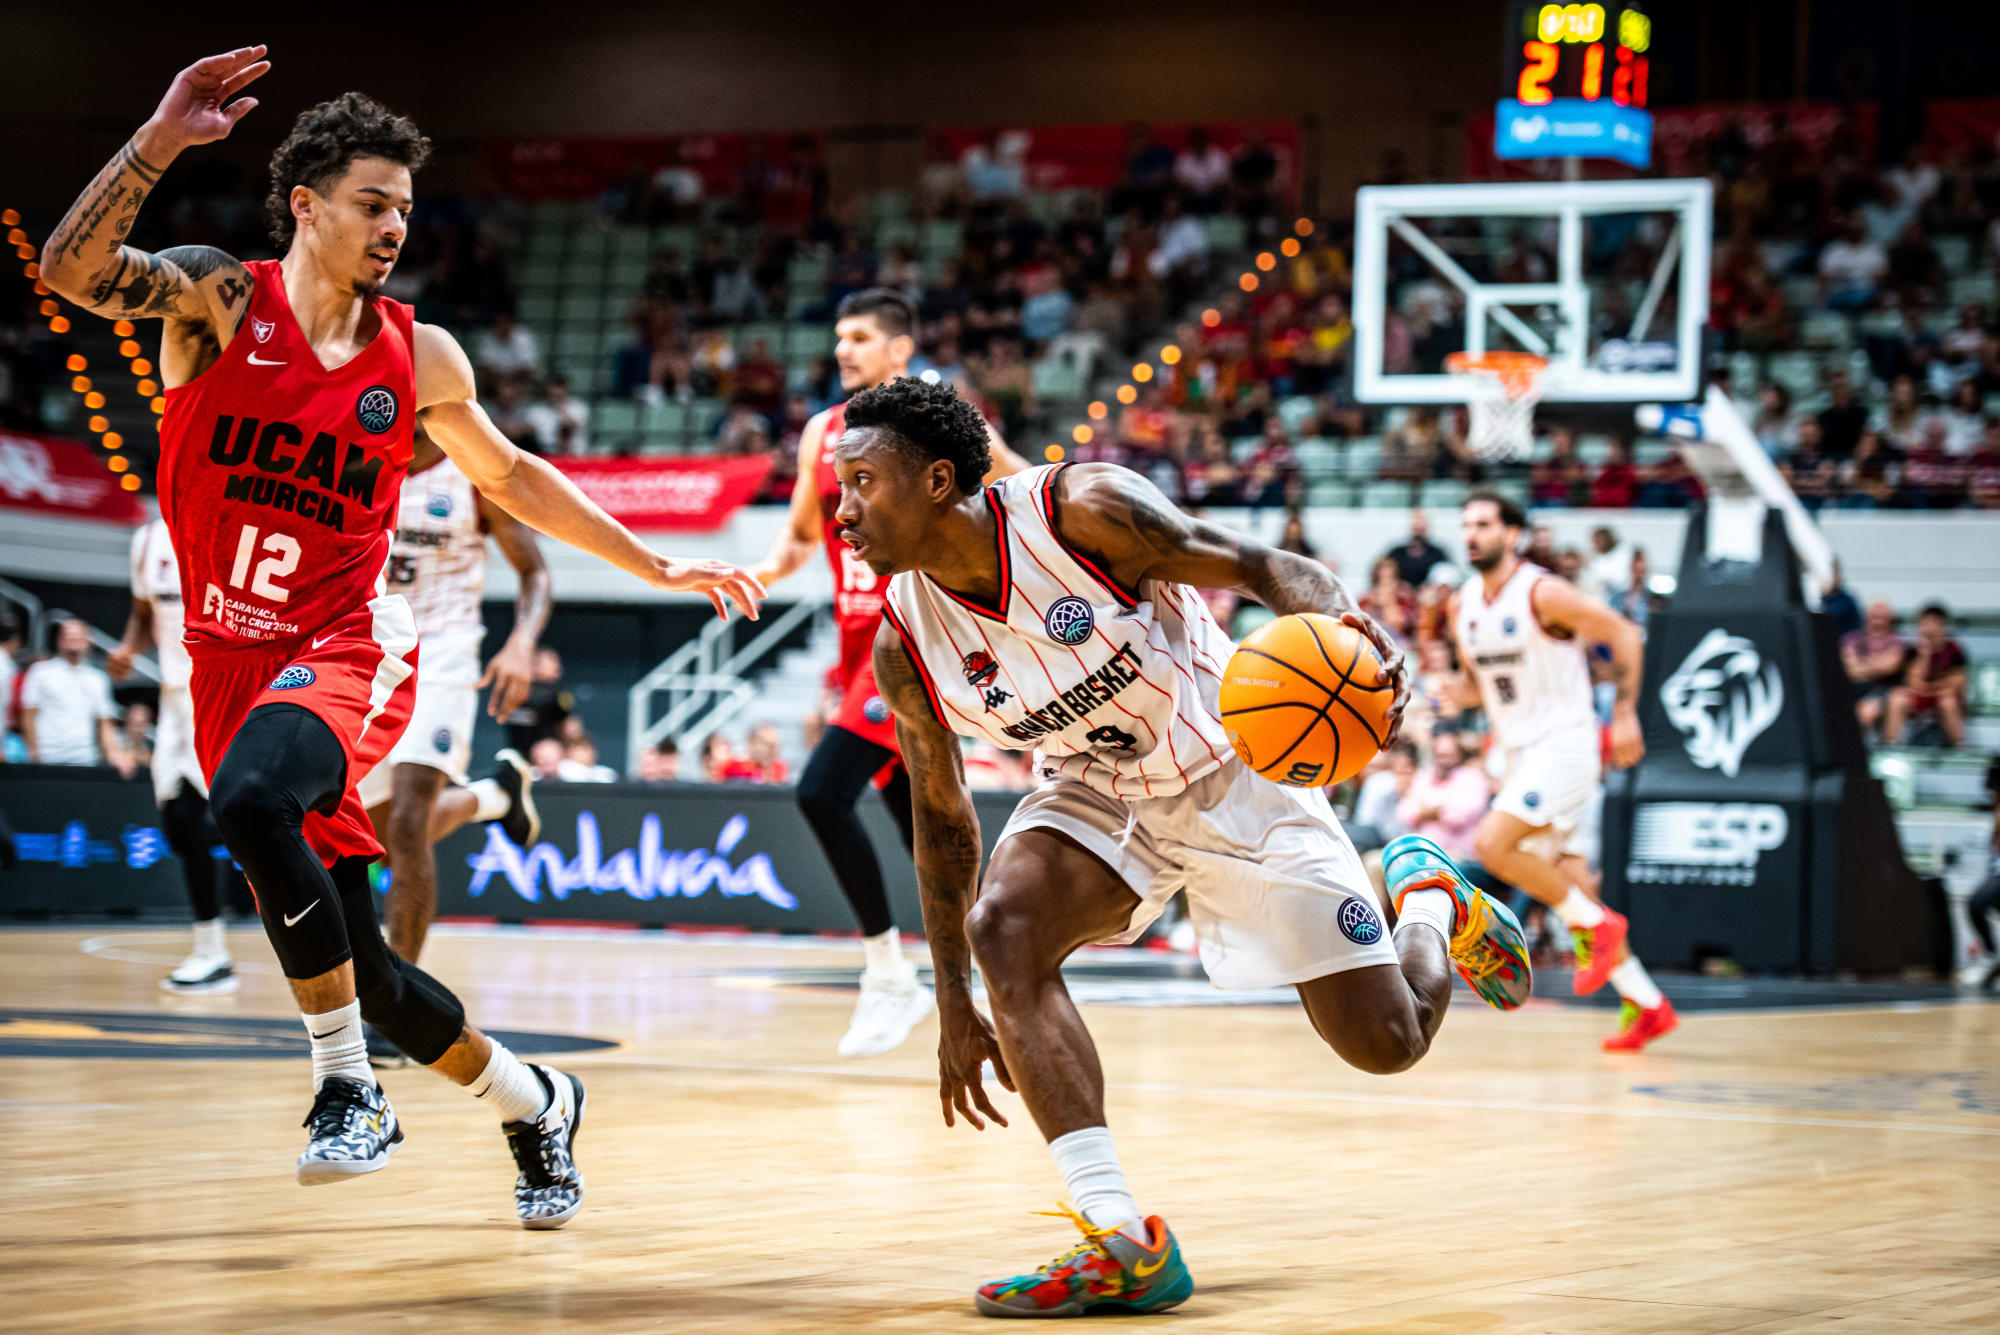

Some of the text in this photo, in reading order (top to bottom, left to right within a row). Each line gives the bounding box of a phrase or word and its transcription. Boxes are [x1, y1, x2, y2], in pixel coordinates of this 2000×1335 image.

[208, 414, 385, 511] UCAM
[223, 474, 345, 534] MURCIA
[229, 524, 302, 603] 12
[225, 598, 278, 620] CARAVACA
[235, 613, 247, 623] LA
[248, 617, 273, 630] CRUZ
[273, 622, 299, 633] 2024
[239, 626, 276, 640] JUBILAR
[1060, 641, 1143, 718] BASKET
